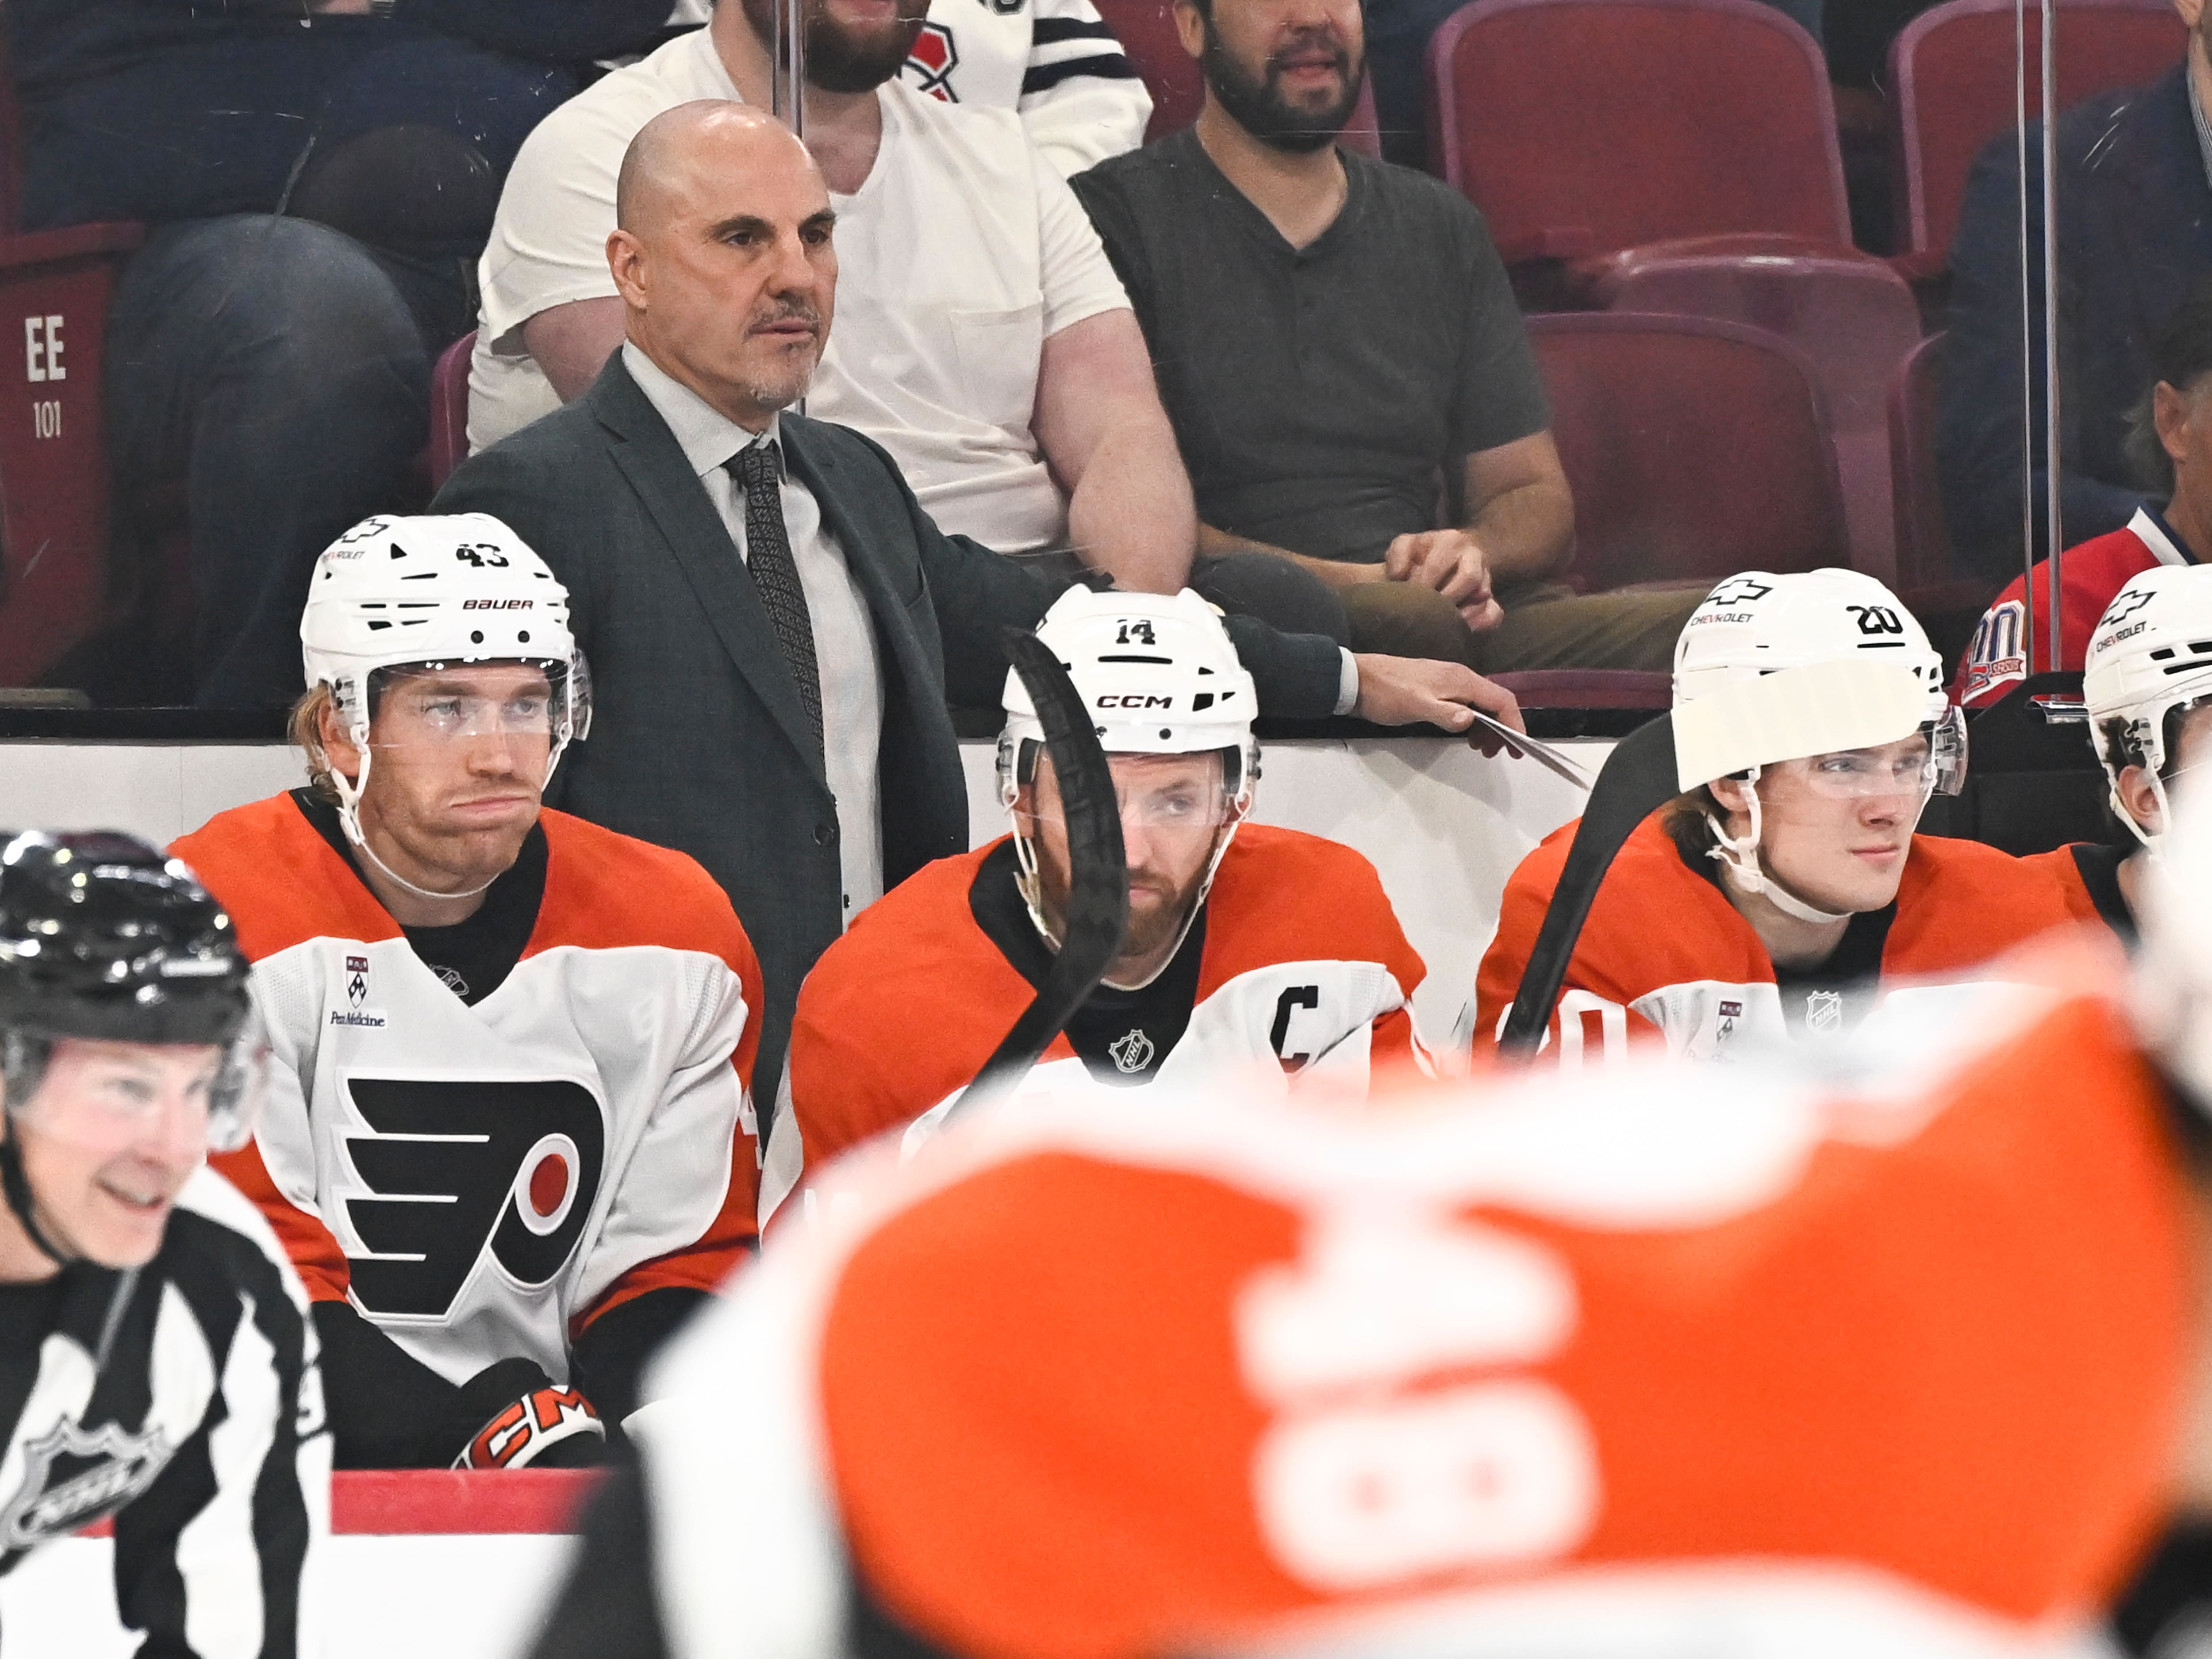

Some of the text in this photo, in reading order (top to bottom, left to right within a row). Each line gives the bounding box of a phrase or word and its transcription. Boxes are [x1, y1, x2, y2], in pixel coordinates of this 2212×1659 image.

[25, 315, 66, 383] EE
[33, 400, 61, 438] 101
[456, 543, 510, 568] 43
[462, 599, 534, 610] BAUER
[1115, 619, 1156, 645] 14
[1690, 613, 1755, 626] CHEVROLET
[1846, 605, 1903, 634] 20
[2096, 620, 2147, 653] CHEVROLET
[1096, 695, 1173, 709] CCM
[1815, 1004, 1836, 1026] NHL
[1270, 985, 1318, 1073] C
[1125, 1041, 1141, 1067] NHL
